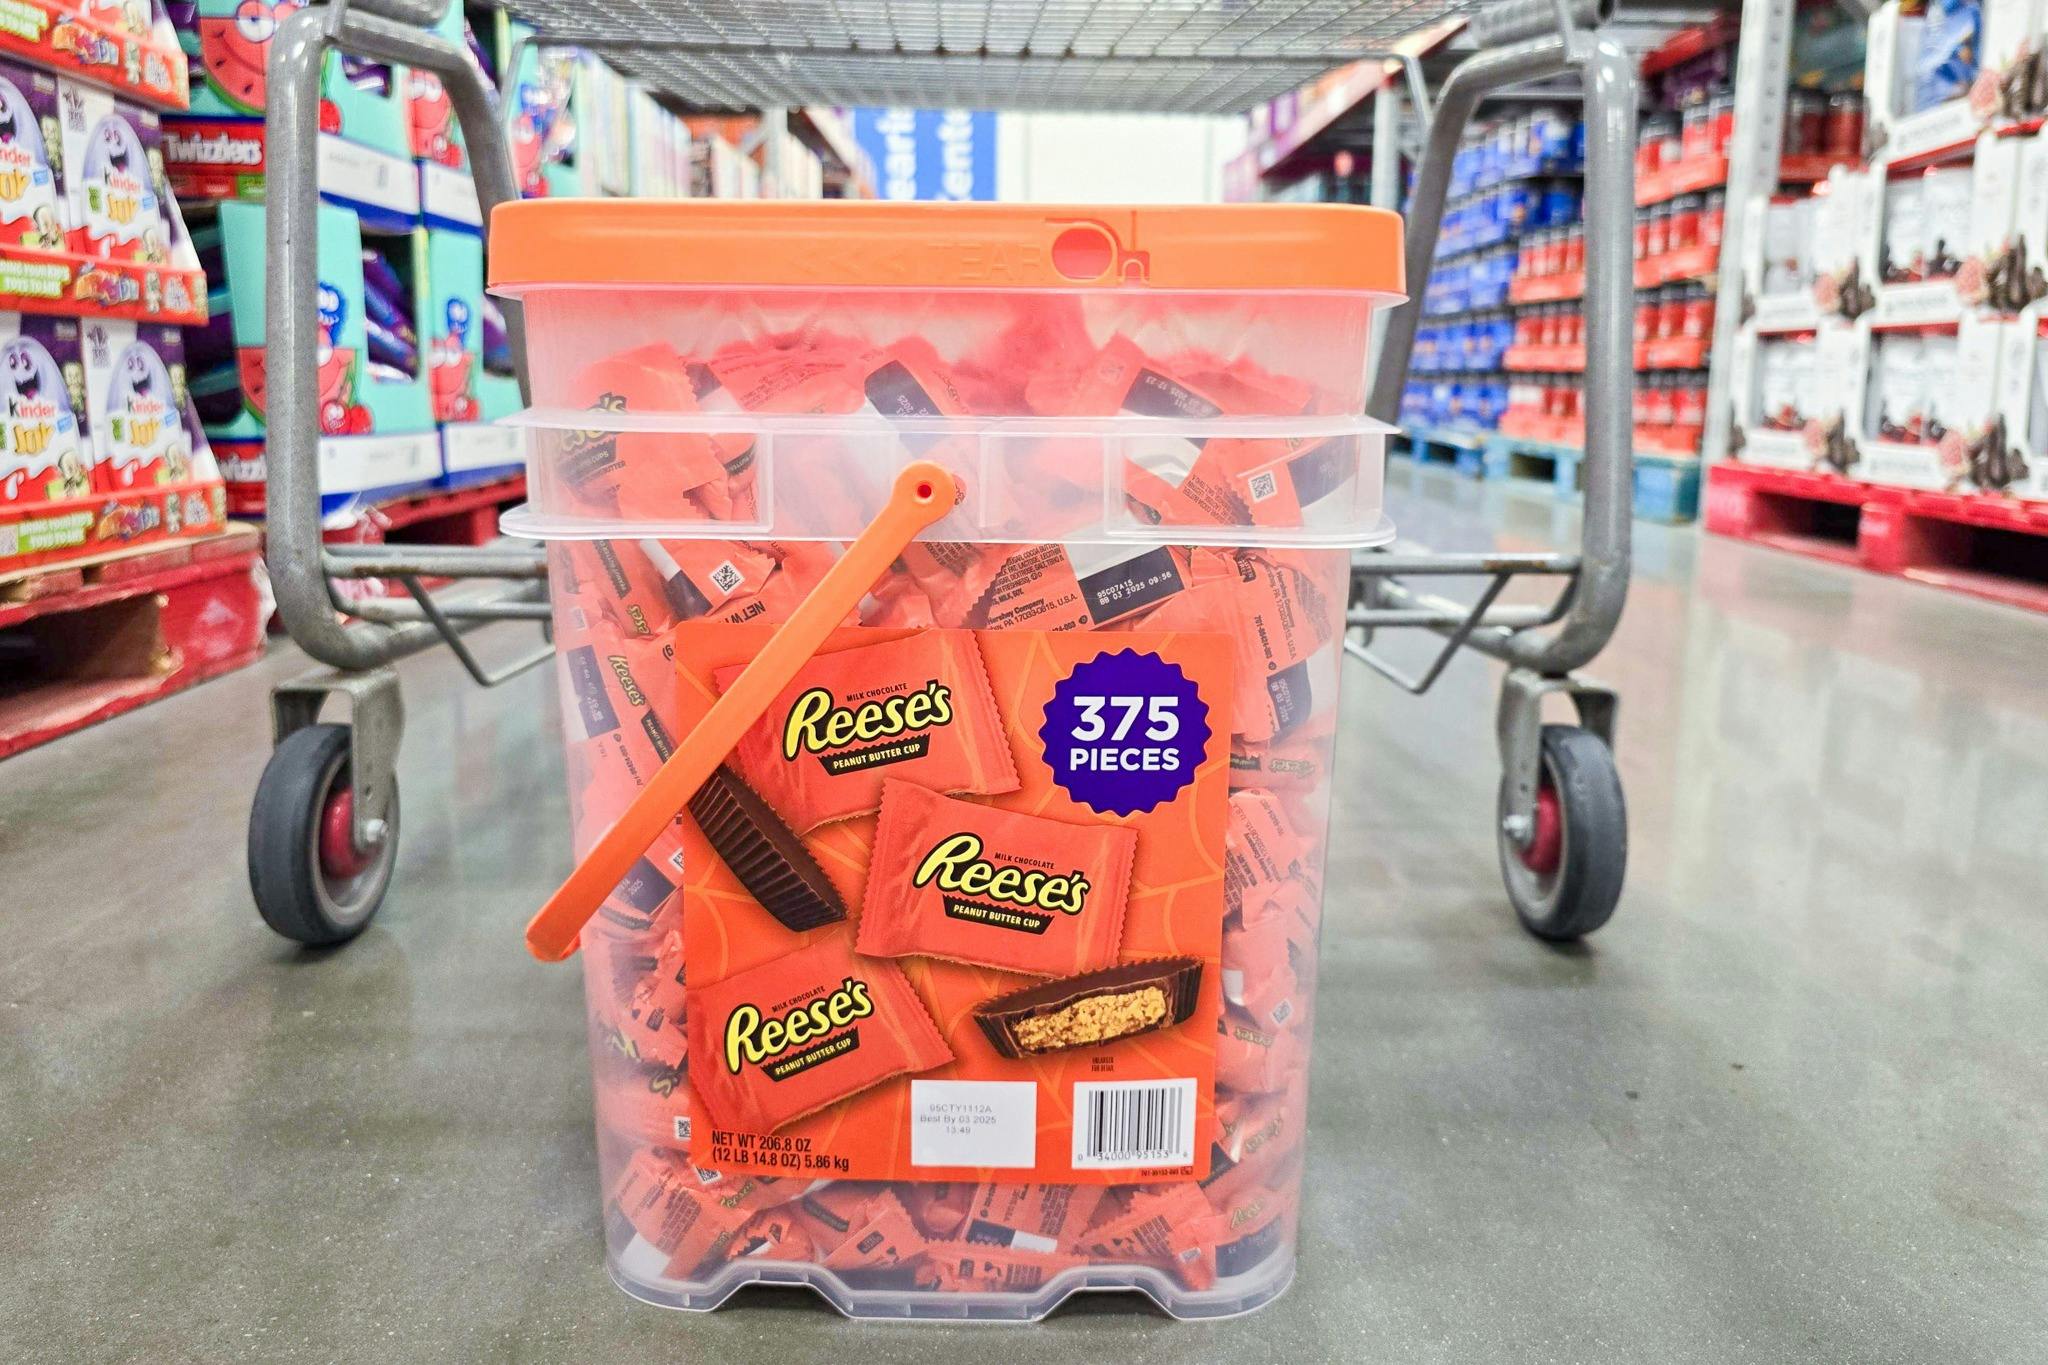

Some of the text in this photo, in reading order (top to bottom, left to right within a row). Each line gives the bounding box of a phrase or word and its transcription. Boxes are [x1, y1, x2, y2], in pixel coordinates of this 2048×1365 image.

[1125, 584, 1146, 598] 2025
[741, 600, 766, 620] NET
[1014, 598, 1045, 614] Company
[846, 683, 908, 702] MILK CHOCOLATE
[783, 680, 953, 761] Reese's
[1070, 696, 1180, 742] 375
[833, 743, 921, 769] PEANUT BUTTER CUP
[1070, 747, 1180, 771] PIECES
[994, 851, 1055, 870] MILK CHOCOLATE
[913, 833, 1091, 915] Reese's
[953, 904, 1041, 929] PEANUT BUTTER CUP
[771, 985, 826, 1013] MILK CHOCOLATE
[725, 977, 874, 1075] Reese's
[774, 1038, 852, 1076] PEANUT BUTTER CUP
[919, 1115, 997, 1125] Best By 03 2025
[711, 1130, 812, 1152] NET WT 206.8 OZ
[712, 1146, 850, 1172] (12 LB 14.8 OZ) 5.86 kg
